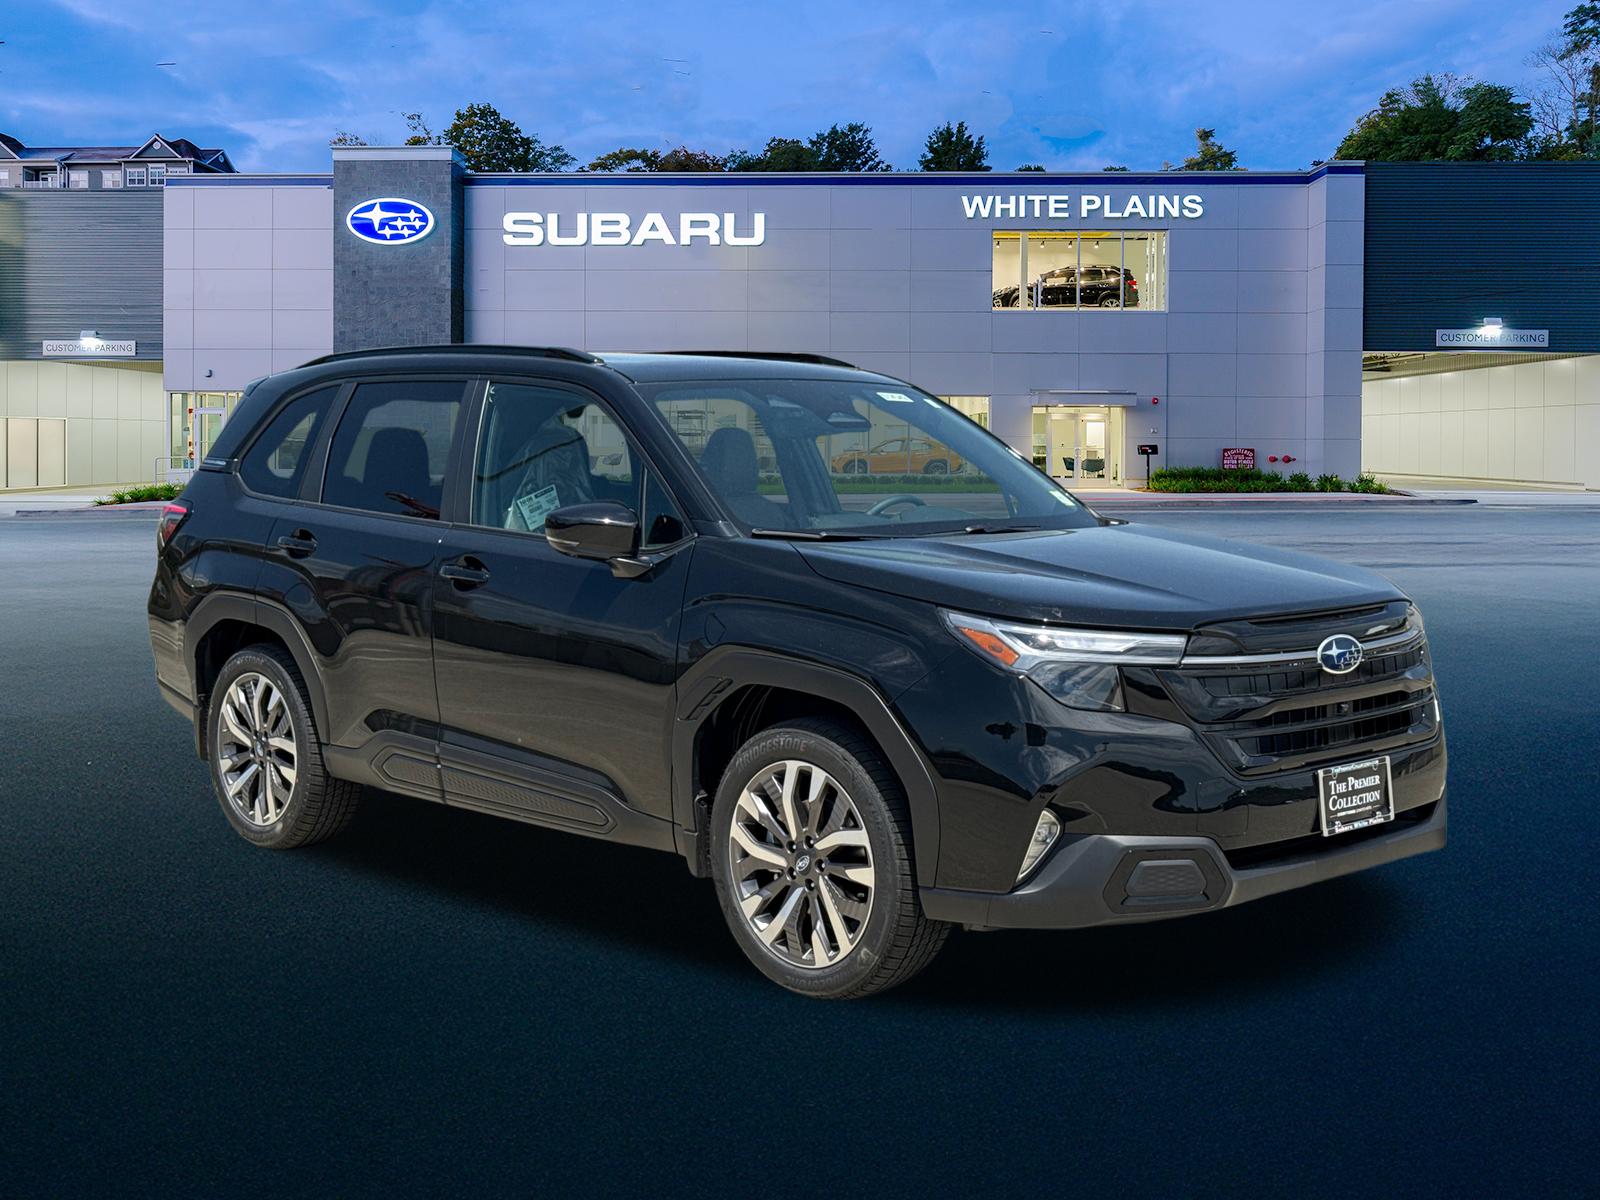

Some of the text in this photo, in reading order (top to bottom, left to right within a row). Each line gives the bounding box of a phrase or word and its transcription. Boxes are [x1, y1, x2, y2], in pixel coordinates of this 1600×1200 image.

[961, 195, 1204, 218] WHITE PLAINS
[502, 212, 765, 246] SUBARU
[1440, 333, 1545, 342] CUSTOMER PARKING
[46, 344, 133, 352] CUSTOMER PARKING
[1329, 775, 1381, 795] THE PREMIER
[1328, 790, 1381, 811] COLLECTION
